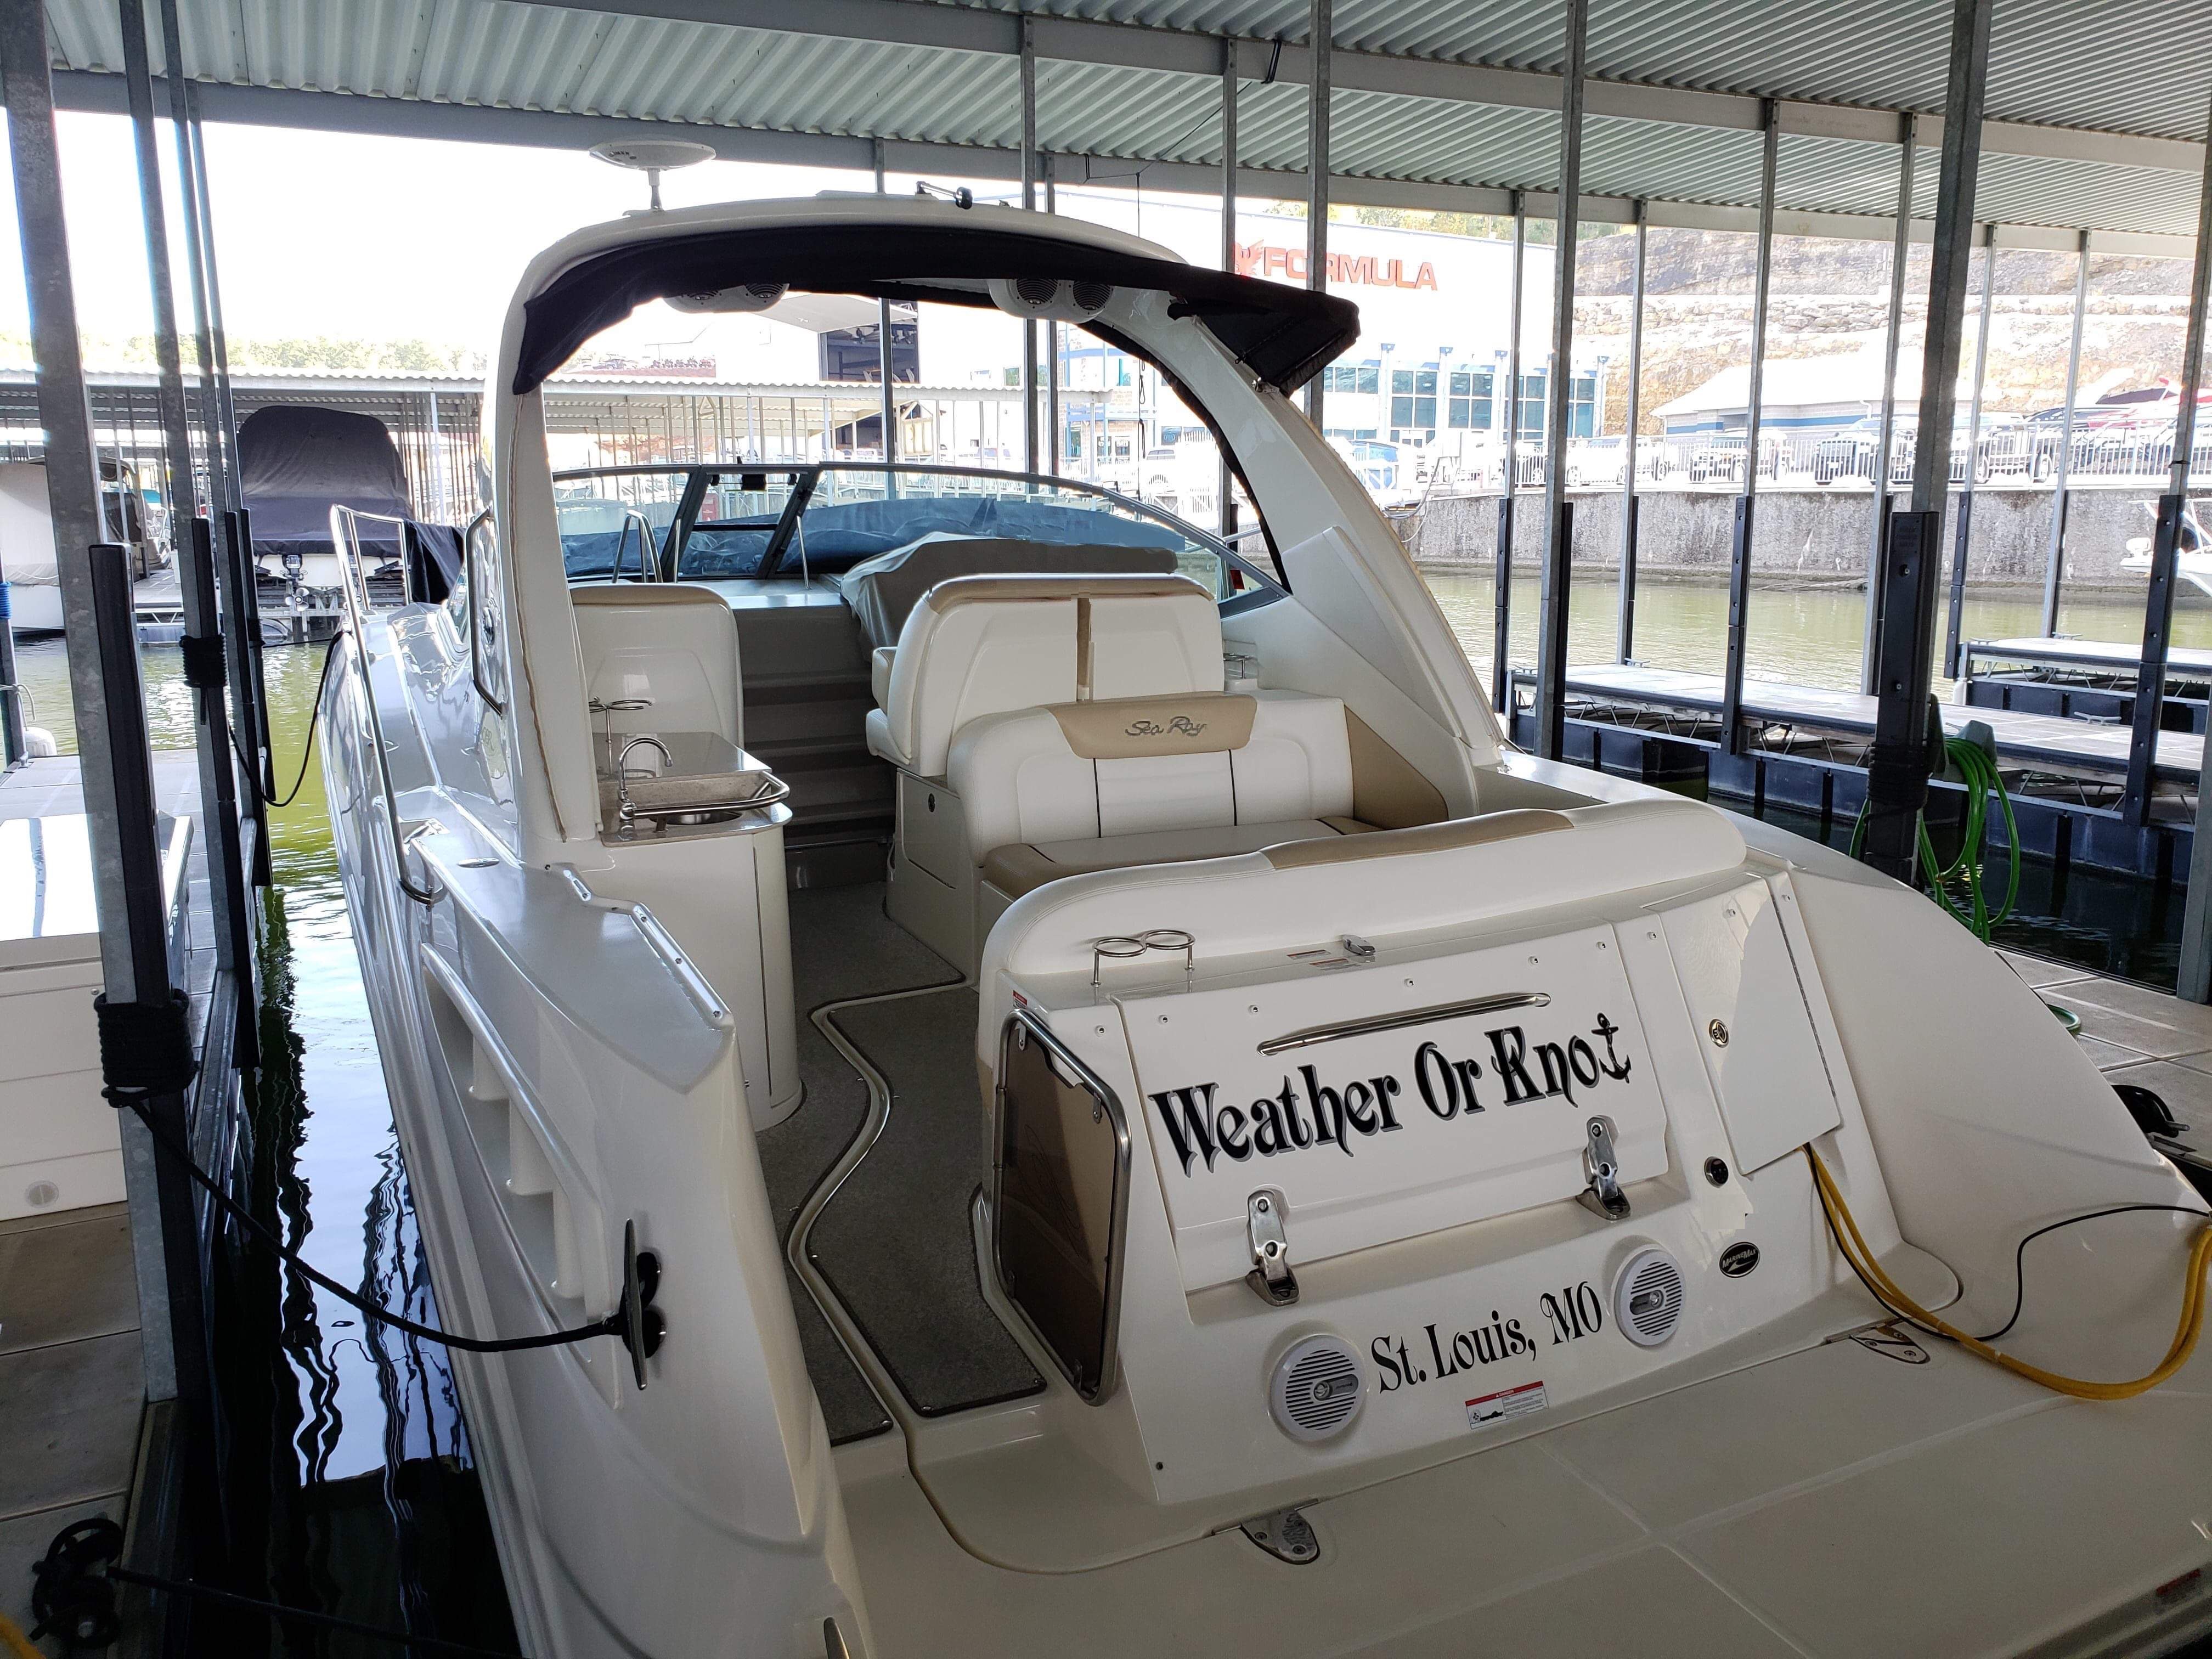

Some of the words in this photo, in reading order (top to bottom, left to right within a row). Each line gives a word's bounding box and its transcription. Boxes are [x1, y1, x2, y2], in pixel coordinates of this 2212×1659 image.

[1264, 247, 1437, 291] FORMULA
[1125, 720, 1164, 736] Sea
[1167, 716, 1207, 736] Ray
[1147, 1064, 1403, 1178] Weather
[1414, 1041, 1485, 1121] Or
[1371, 1335, 1426, 1394] St.
[1423, 1310, 1537, 1379] Louis,
[1540, 1282, 1602, 1345] MO
